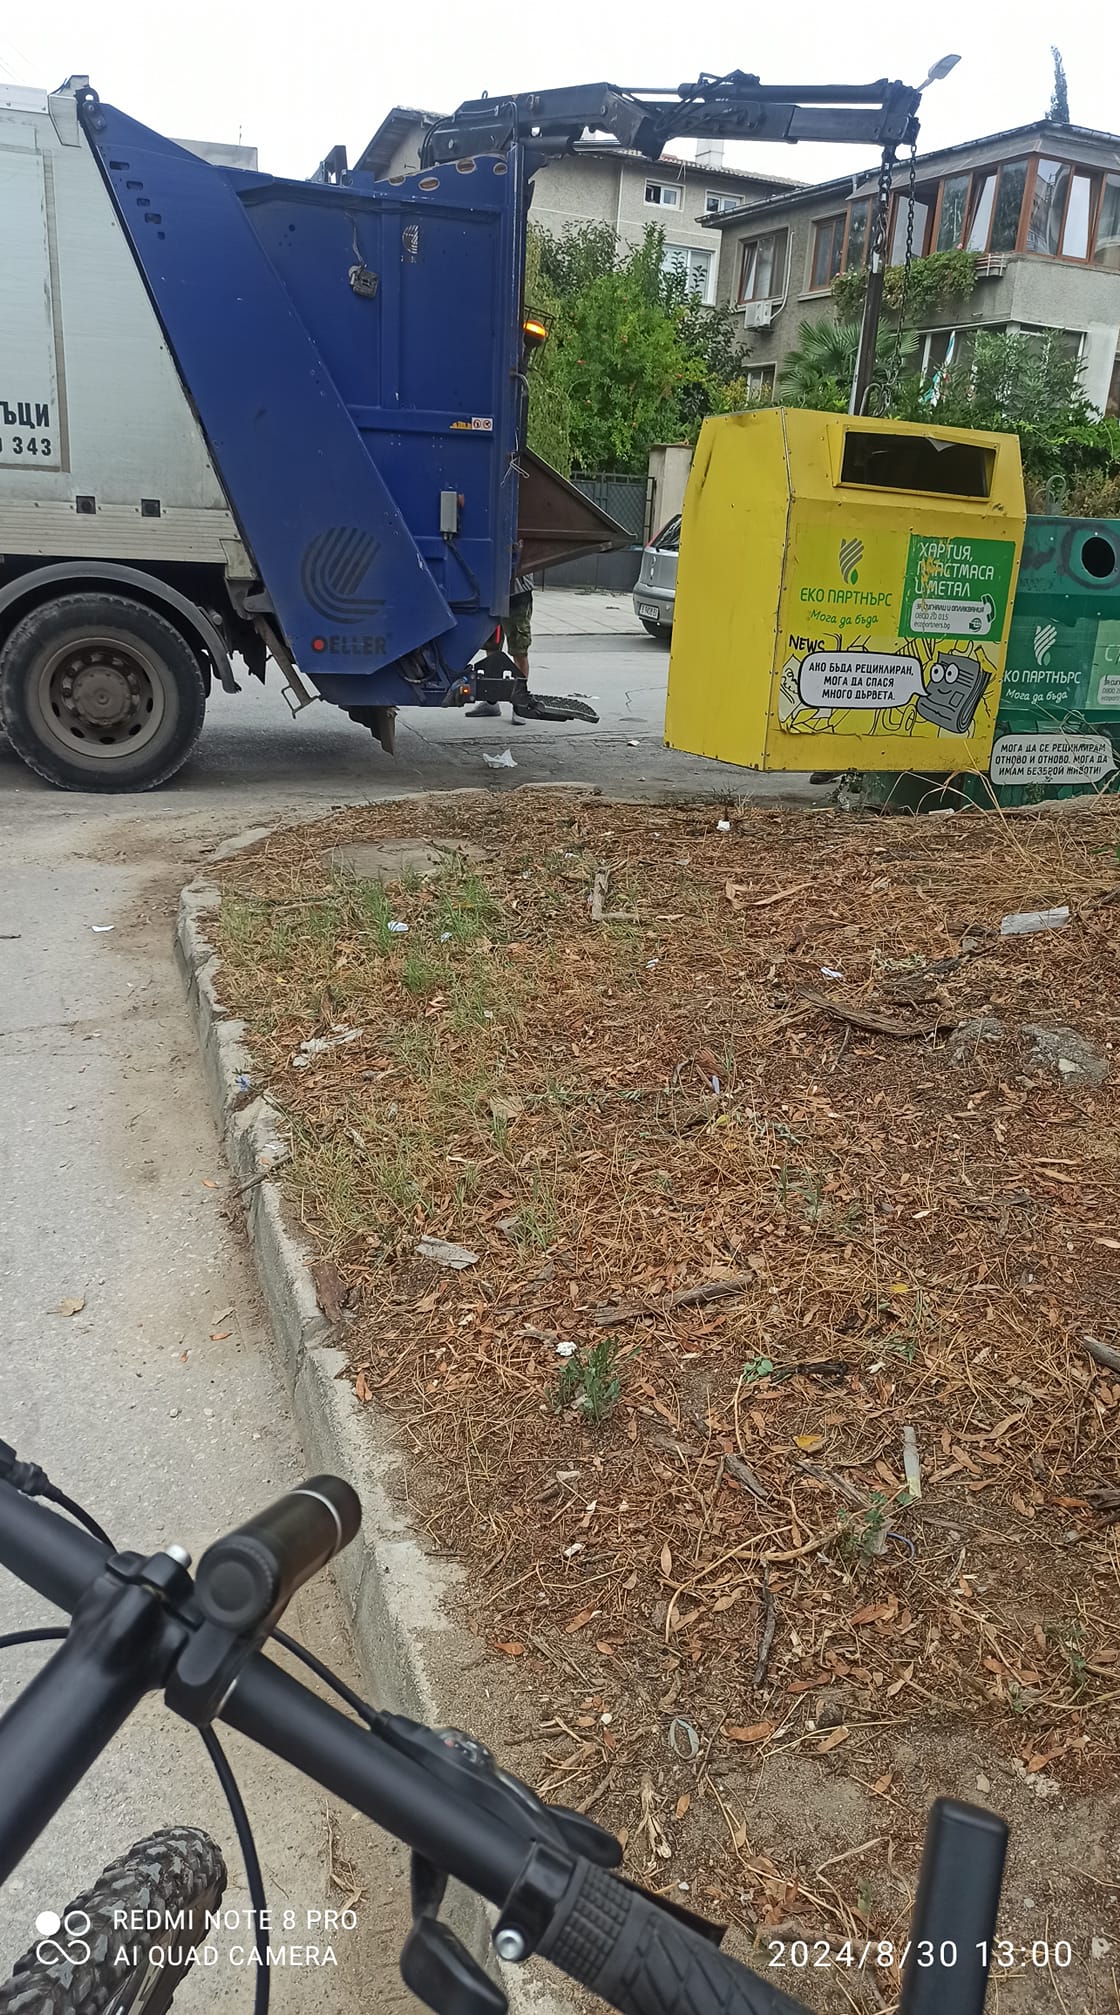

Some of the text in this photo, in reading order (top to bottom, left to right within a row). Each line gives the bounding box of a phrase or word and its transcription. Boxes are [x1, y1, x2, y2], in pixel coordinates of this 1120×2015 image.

[12, 436, 51, 456] 343
[919, 542, 973, 562] ХАРТИЯ,
[917, 560, 994, 580] ПАСТМАСА
[800, 587, 893, 606] ЕКО ПАРТНЪРС
[926, 580, 971, 597] МЕТАЛ
[810, 609, 878, 629] Мога да бъда
[789, 634, 825, 653] NEWS
[808, 662, 914, 676] АКО БЪДА РЕЦИКЛИРАН,
[1003, 670, 1082, 684] КО ПАРТНЪРС
[823, 676, 895, 688] МОГА ДА СПАСЯ
[821, 689, 896, 701] МНОГО ДЪРВЕТА.
[1006, 688, 1068, 704] Мога да бъда
[1000, 744, 1023, 753] МОГА
[1025, 744, 1037, 753] ДА
[1039, 744, 1050, 753] СЕ
[995, 755, 1027, 764] ОТНОВО
[1029, 755, 1036, 764] И
[1073, 755, 1095, 764] МОГА
[1096, 755, 1108, 764] ДА
[999, 767, 1024, 776] ИМАМ
